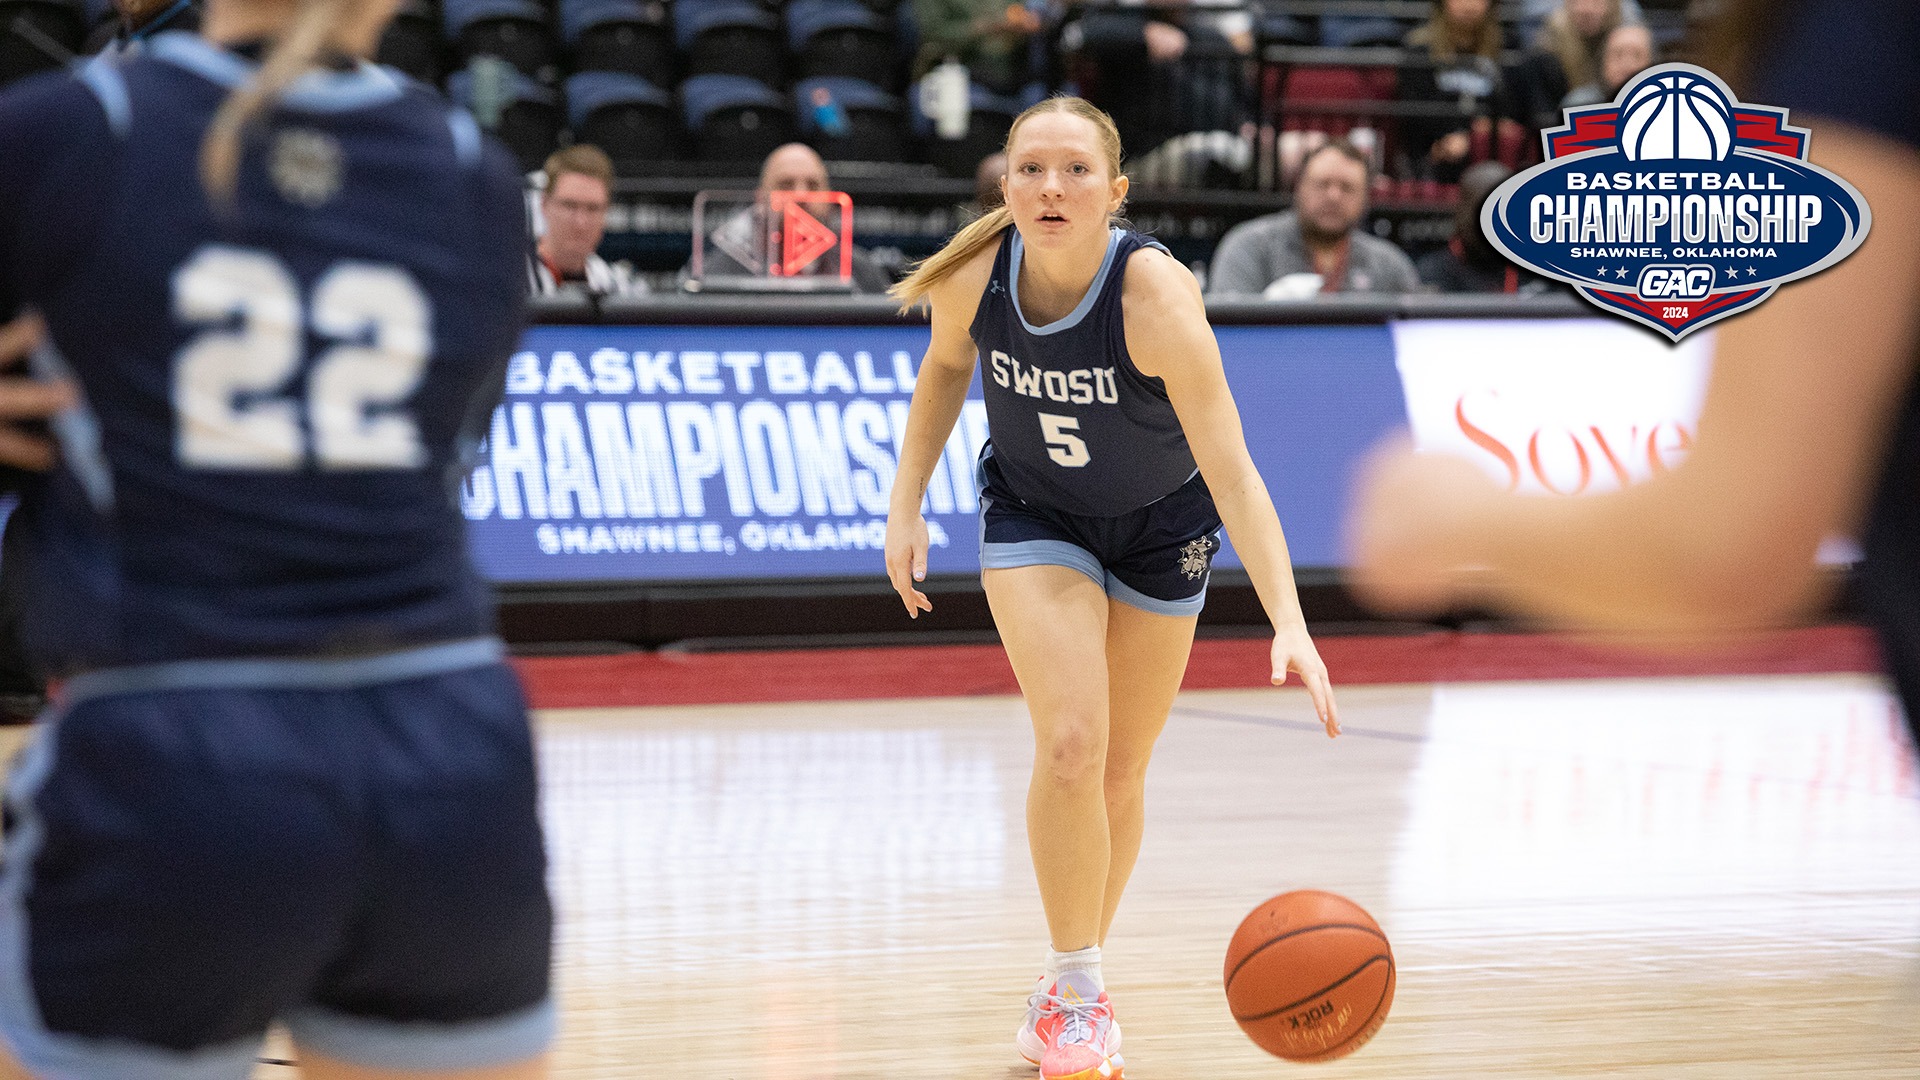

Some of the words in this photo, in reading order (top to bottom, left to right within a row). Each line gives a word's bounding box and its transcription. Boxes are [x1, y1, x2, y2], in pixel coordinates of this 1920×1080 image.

[169, 246, 433, 471] 22
[505, 348, 919, 394] BASKETBALL
[990, 349, 1119, 405] SWOSU
[1037, 411, 1092, 468] 5
[537, 522, 737, 555] SHAWNEE,
[739, 518, 949, 551] OKLAHOA
